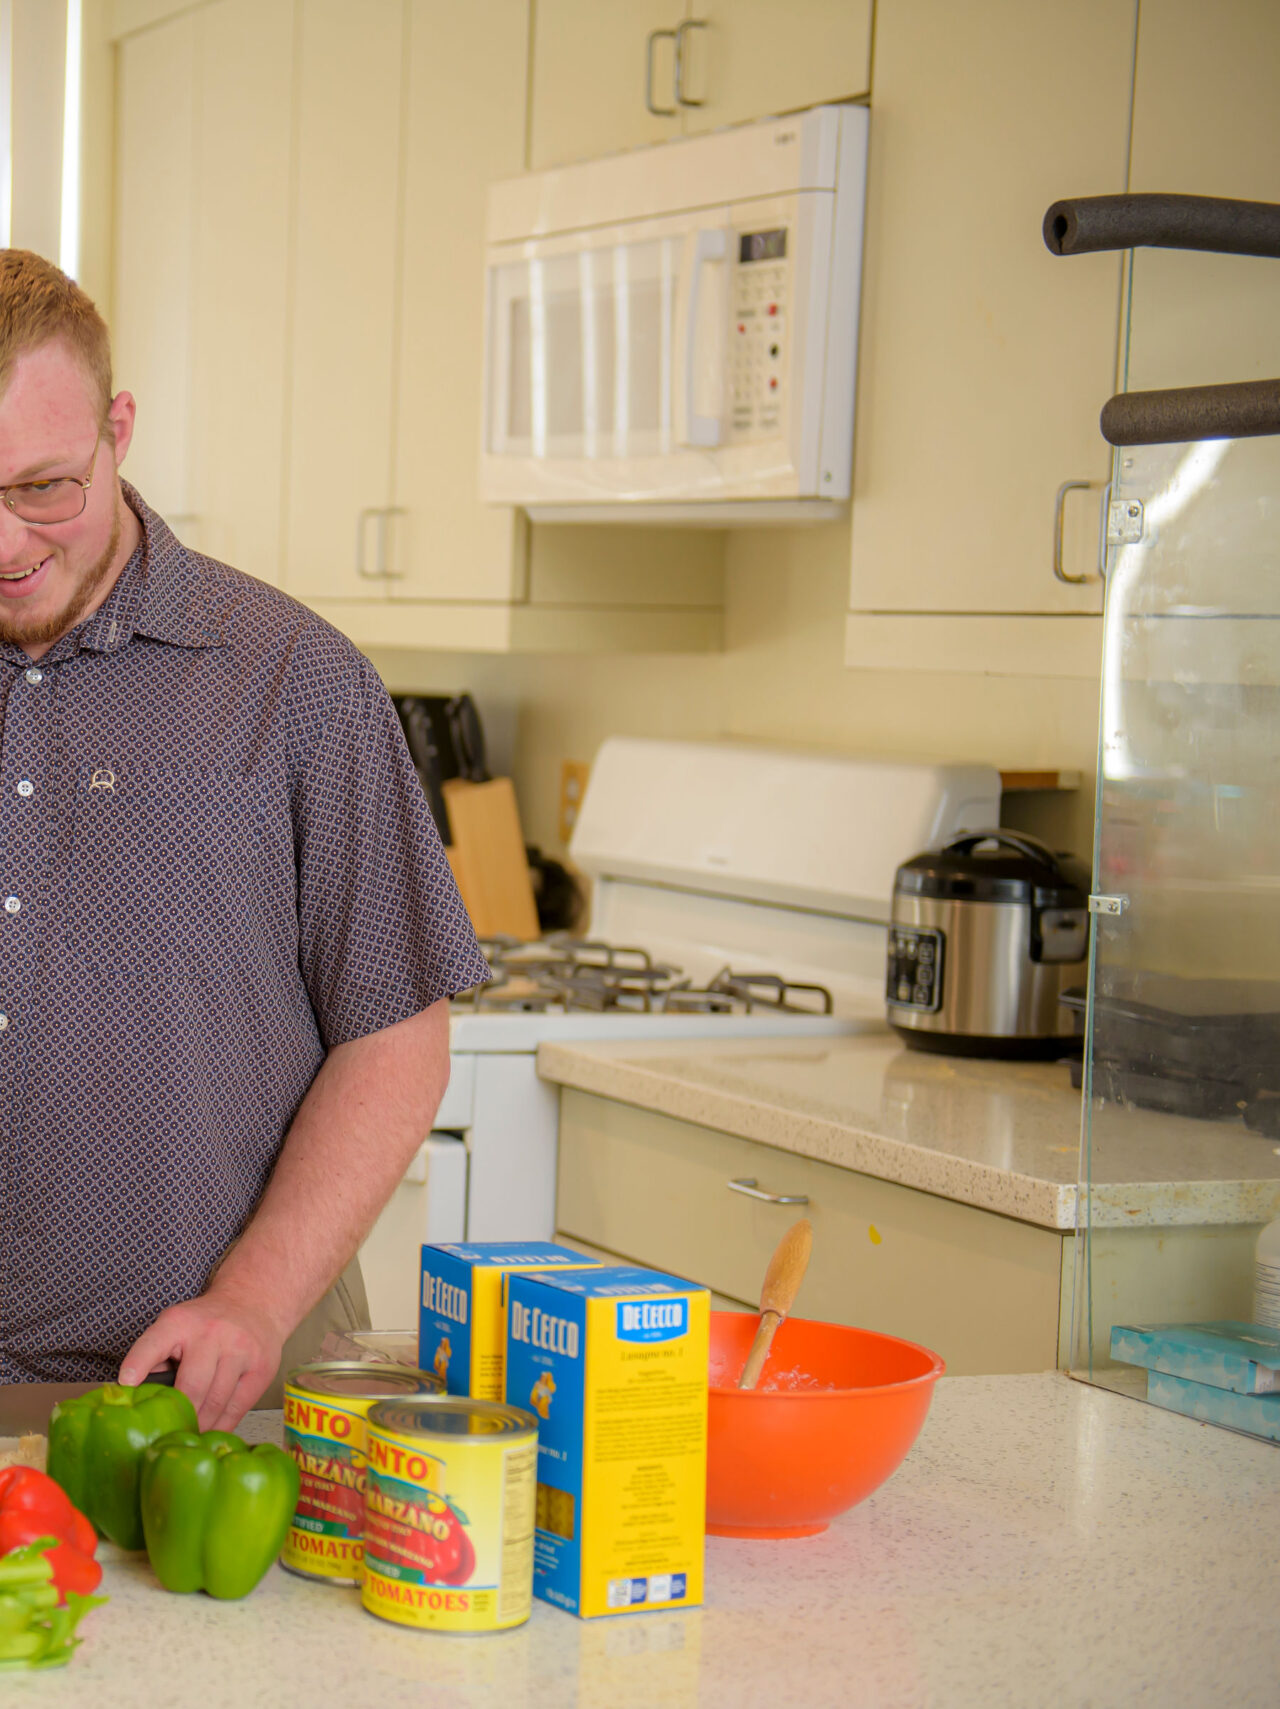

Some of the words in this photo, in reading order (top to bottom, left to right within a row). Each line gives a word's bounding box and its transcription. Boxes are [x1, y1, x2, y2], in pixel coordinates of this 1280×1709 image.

[531, 1307, 580, 1360] CECCO
[641, 1302, 683, 1330] CECCO
[284, 1398, 352, 1439] ENTO
[367, 1437, 428, 1480] ENTO
[291, 1531, 365, 1562] TOMATO
[369, 1574, 470, 1613] TOMATOES
